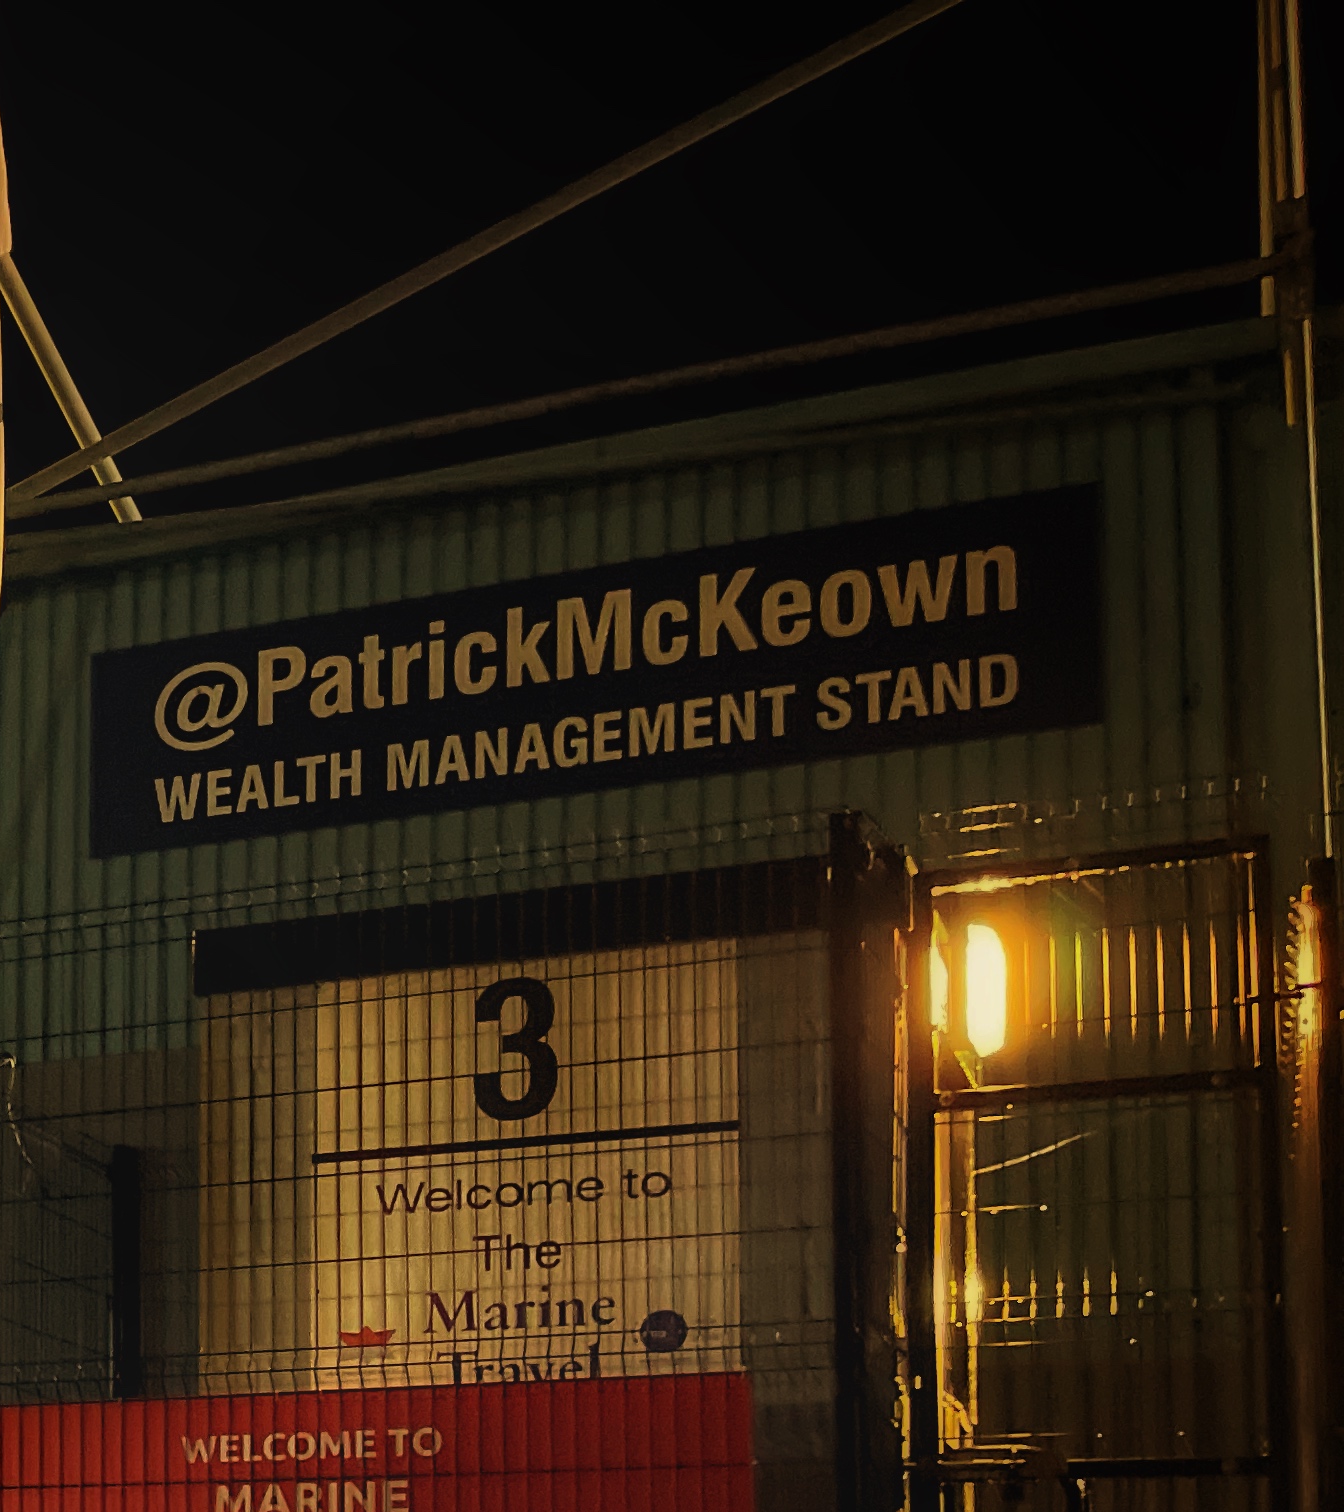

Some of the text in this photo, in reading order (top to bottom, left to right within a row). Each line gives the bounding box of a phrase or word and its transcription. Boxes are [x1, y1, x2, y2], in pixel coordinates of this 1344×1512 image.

[154, 544, 1019, 751] @PatrickMcKeown
[154, 653, 1019, 824] WEALTH MANAGEMENT STAND
[474, 977, 557, 1120] 3
[376, 1166, 672, 1216] Welcome to
[473, 1235, 562, 1271] The
[423, 1284, 616, 1334] Marine
[182, 1427, 442, 1464] WELCOME TO
